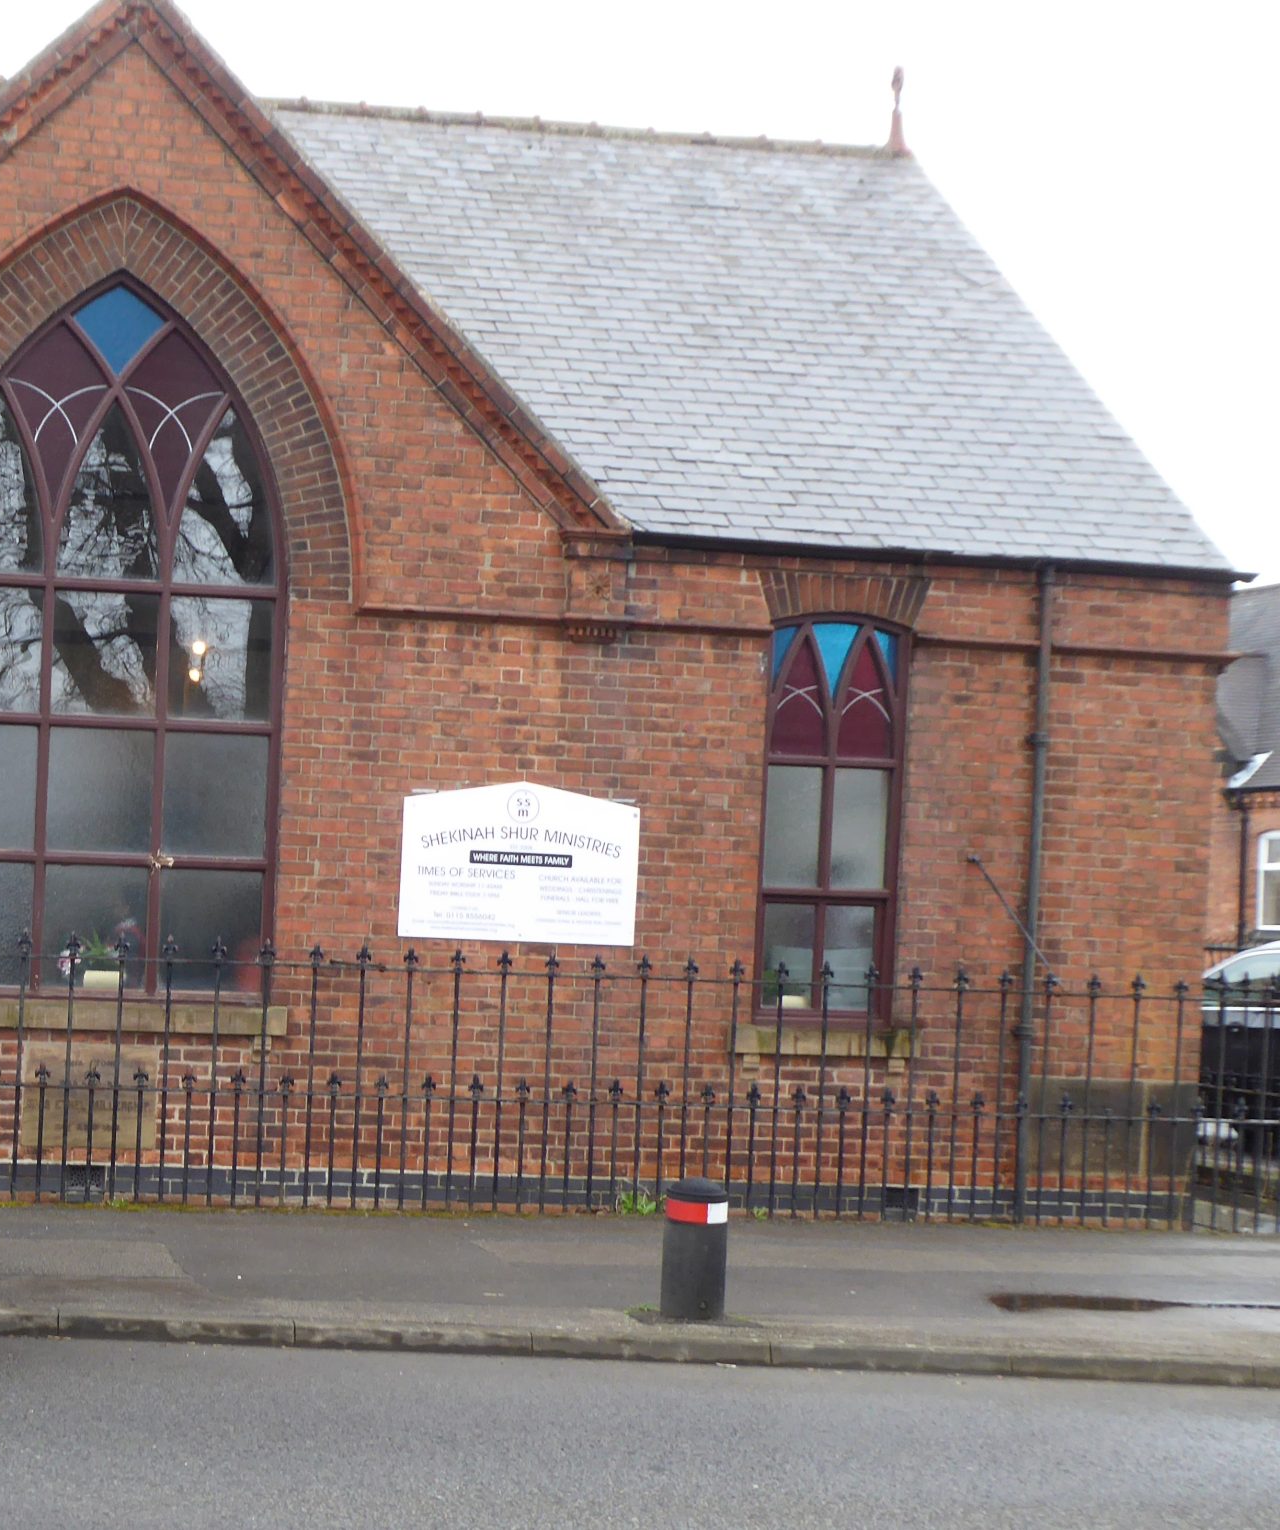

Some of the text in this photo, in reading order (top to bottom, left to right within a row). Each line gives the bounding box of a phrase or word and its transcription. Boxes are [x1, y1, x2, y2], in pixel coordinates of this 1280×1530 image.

[421, 826, 622, 859] SHEKINAH SHUR MINISTRIES
[472, 853, 570, 866] WHERE FAITH MEETS FAMILY
[417, 865, 516, 880] TIMES OF SERVICES
[538, 875, 569, 883] CHURCH
[570, 876, 605, 885] AVAILABLE
[539, 885, 572, 893] WEDDINGS
[540, 895, 571, 903] FUNERALS
